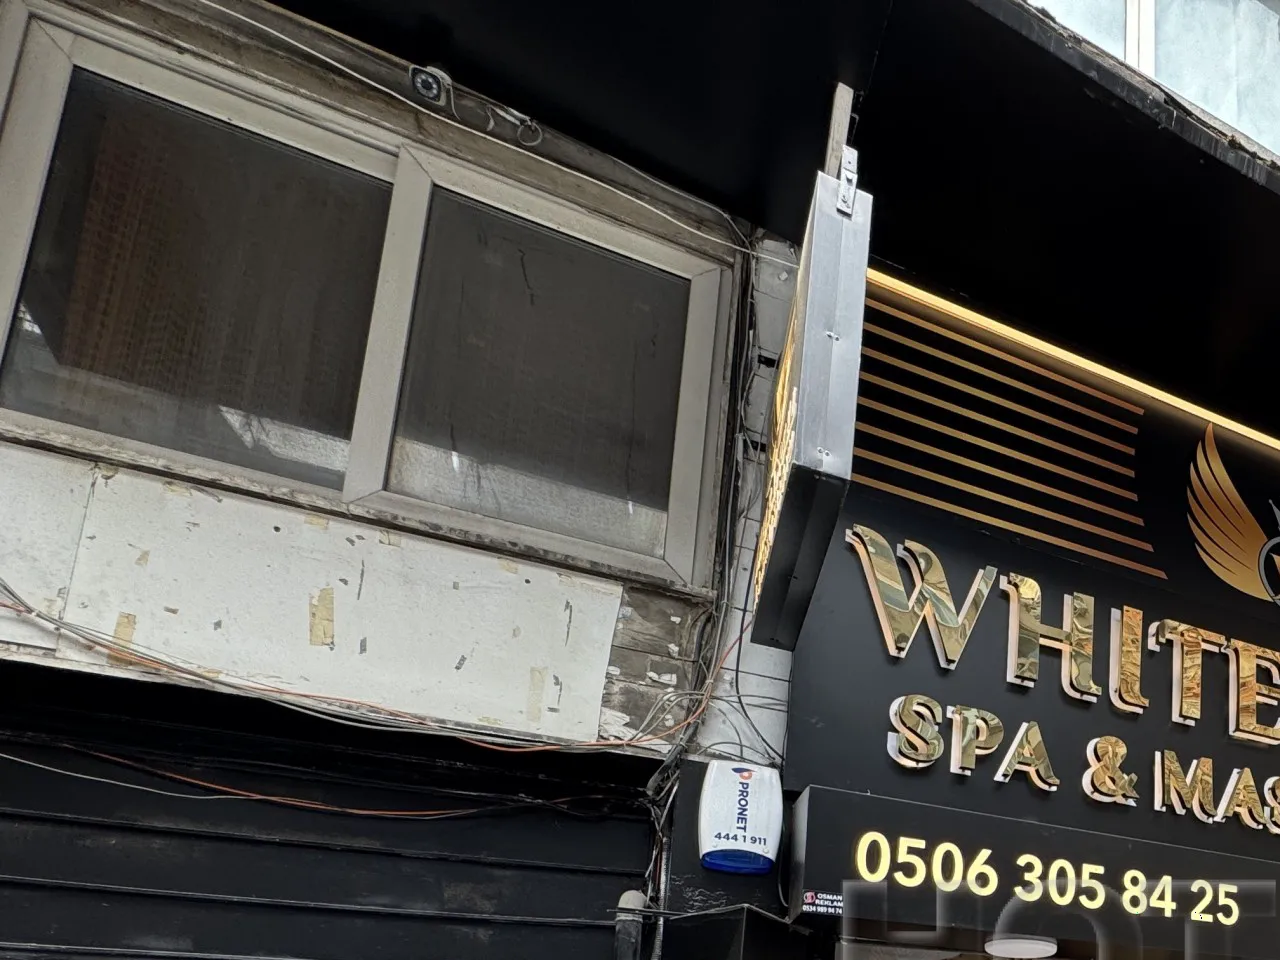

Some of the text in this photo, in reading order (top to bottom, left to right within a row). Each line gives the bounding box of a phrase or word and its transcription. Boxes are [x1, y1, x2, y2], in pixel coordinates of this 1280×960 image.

[887, 693, 1061, 792] SPA
[1082, 735, 1141, 806] &
[735, 781, 750, 833] PRONET
[714, 832, 739, 842] 444
[750, 835, 767, 846] 911
[817, 892, 843, 901] OSMAN
[856, 830, 1240, 926] 0506 305 84 25
